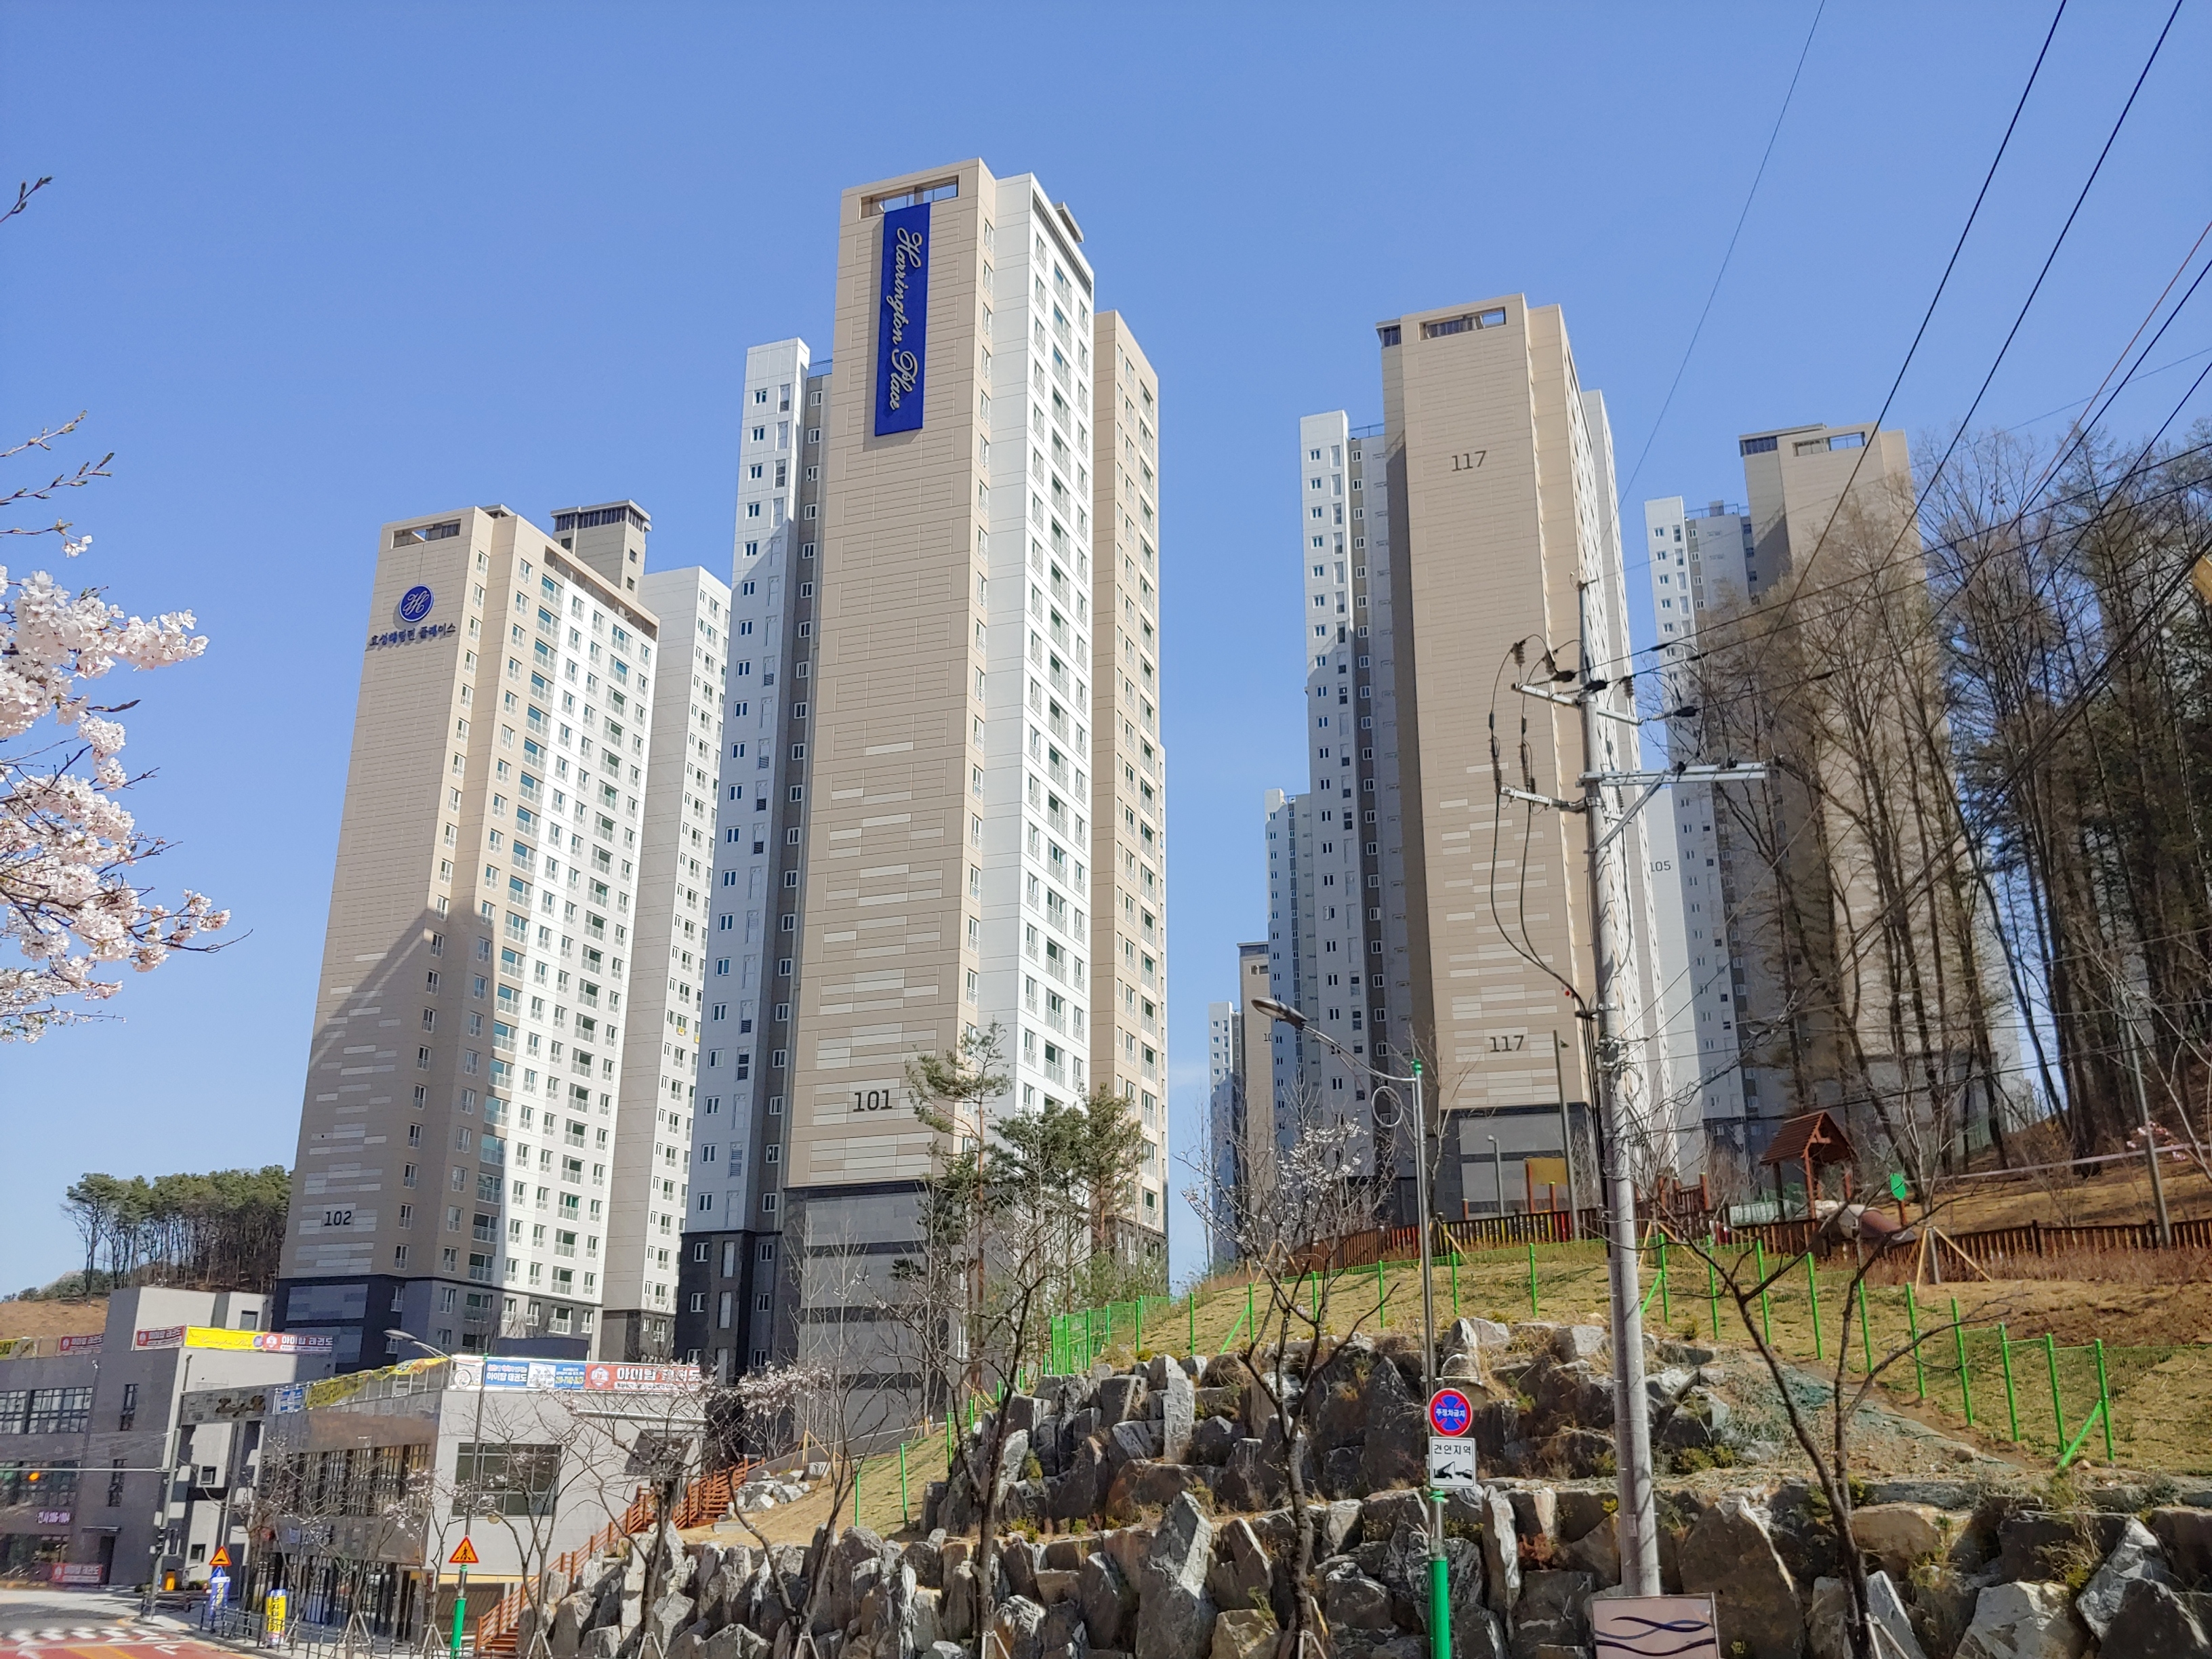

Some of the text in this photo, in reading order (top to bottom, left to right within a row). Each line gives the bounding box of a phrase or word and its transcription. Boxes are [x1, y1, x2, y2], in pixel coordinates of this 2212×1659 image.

[886, 227, 922, 411] Harrington Place
[1451, 450, 1487, 472] 117
[417, 622, 456, 639] 플레이스
[1649, 860, 1671, 873] 105
[1489, 1035, 1524, 1052] 117
[853, 1089, 893, 1112] 101
[324, 1210, 352, 1227] 102
[1435, 1408, 1466, 1418] 주정차금지
[1433, 1444, 1471, 1456] 견인지역
